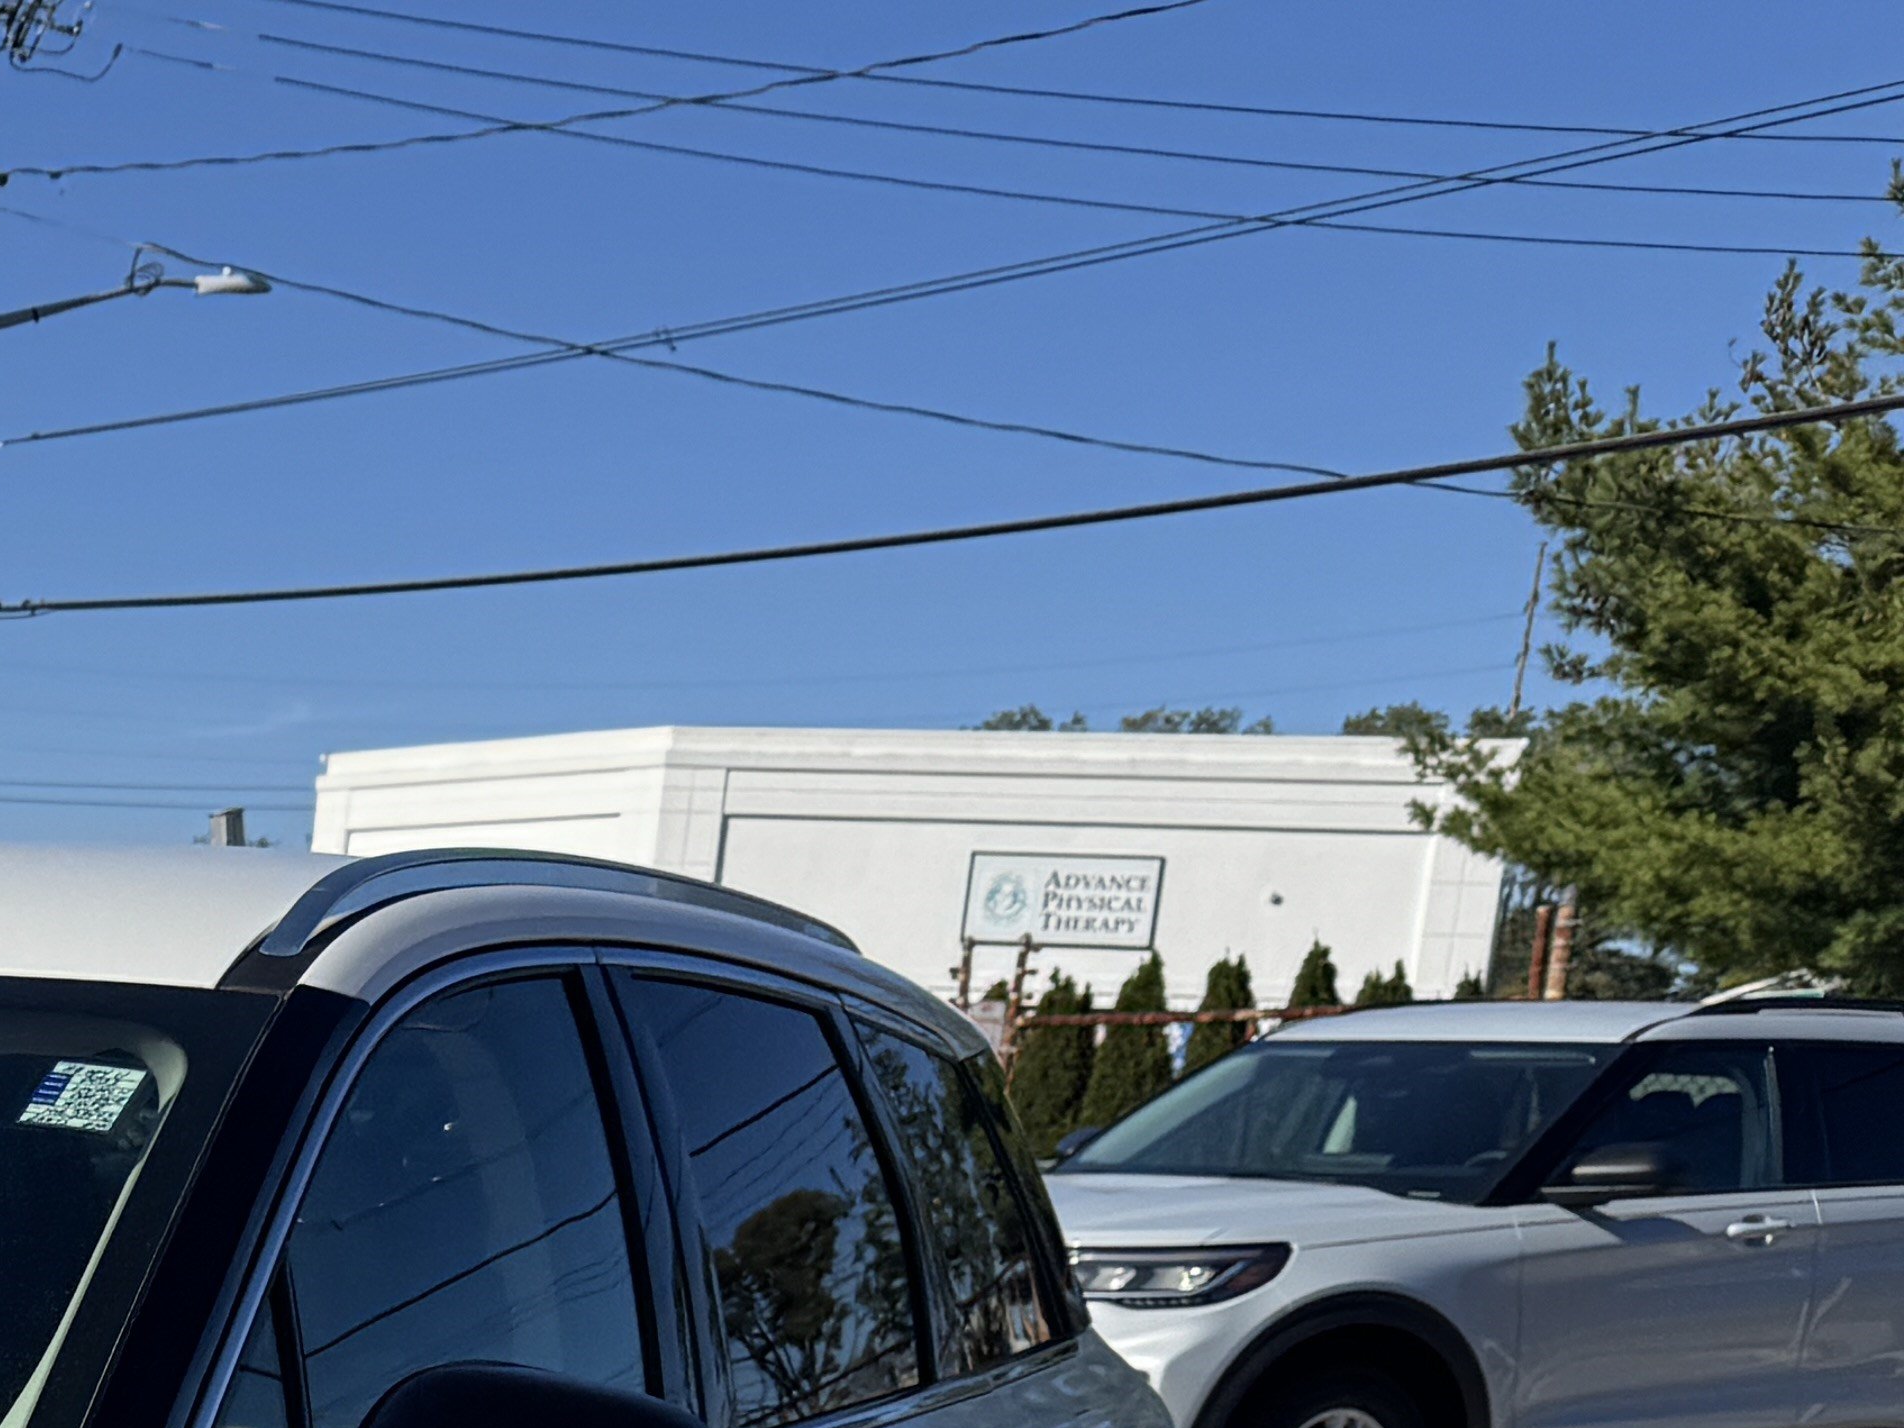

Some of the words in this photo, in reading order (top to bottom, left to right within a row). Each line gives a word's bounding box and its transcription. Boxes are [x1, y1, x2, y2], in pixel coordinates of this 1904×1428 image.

[1044, 870, 1150, 891] ADVANCE
[1042, 891, 1146, 912] PHYSICAL
[1040, 912, 1138, 933] THERAPY
